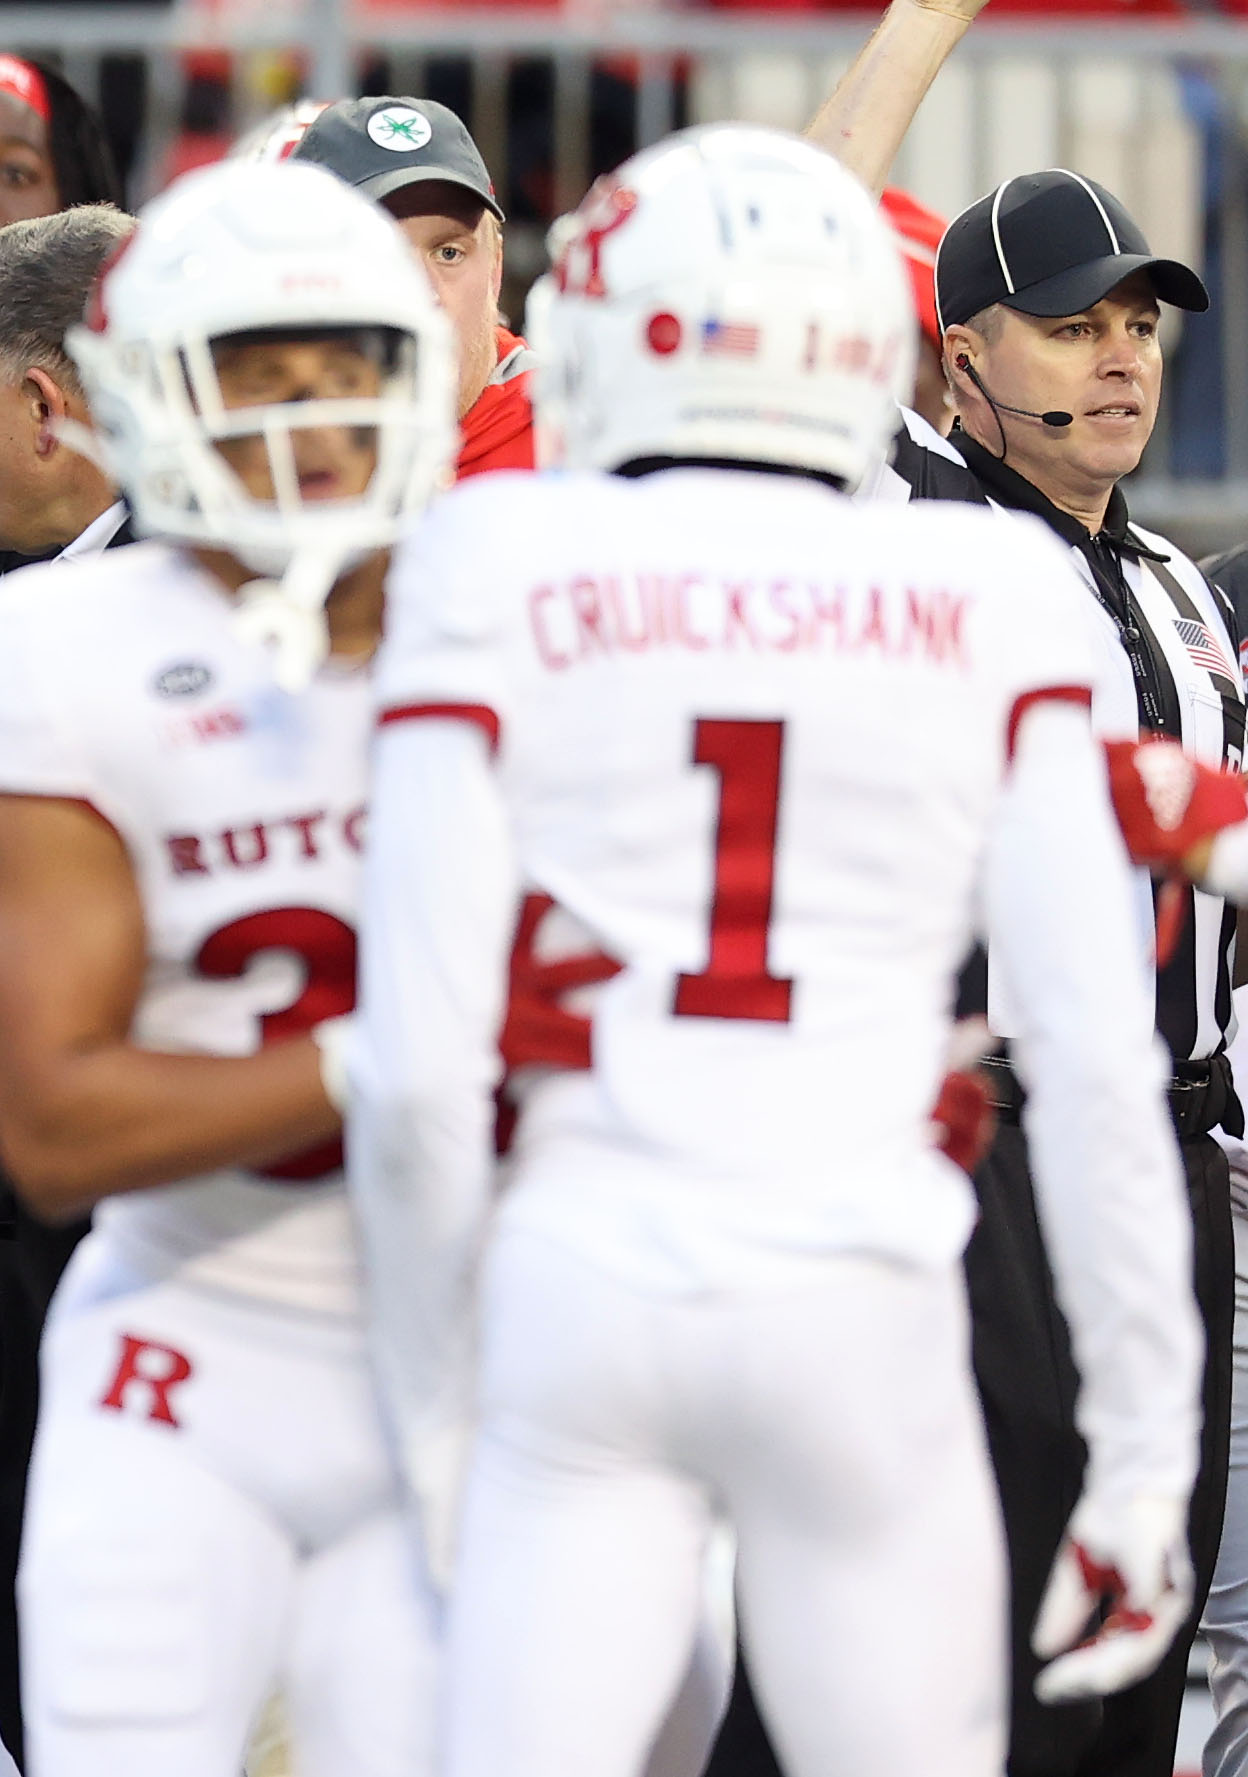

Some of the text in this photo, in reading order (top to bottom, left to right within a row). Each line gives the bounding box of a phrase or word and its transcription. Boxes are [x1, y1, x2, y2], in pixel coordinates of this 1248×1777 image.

[529, 574, 973, 672] CRUICKSHANK
[672, 718, 794, 1022] 1
[100, 1333, 192, 1428] R
